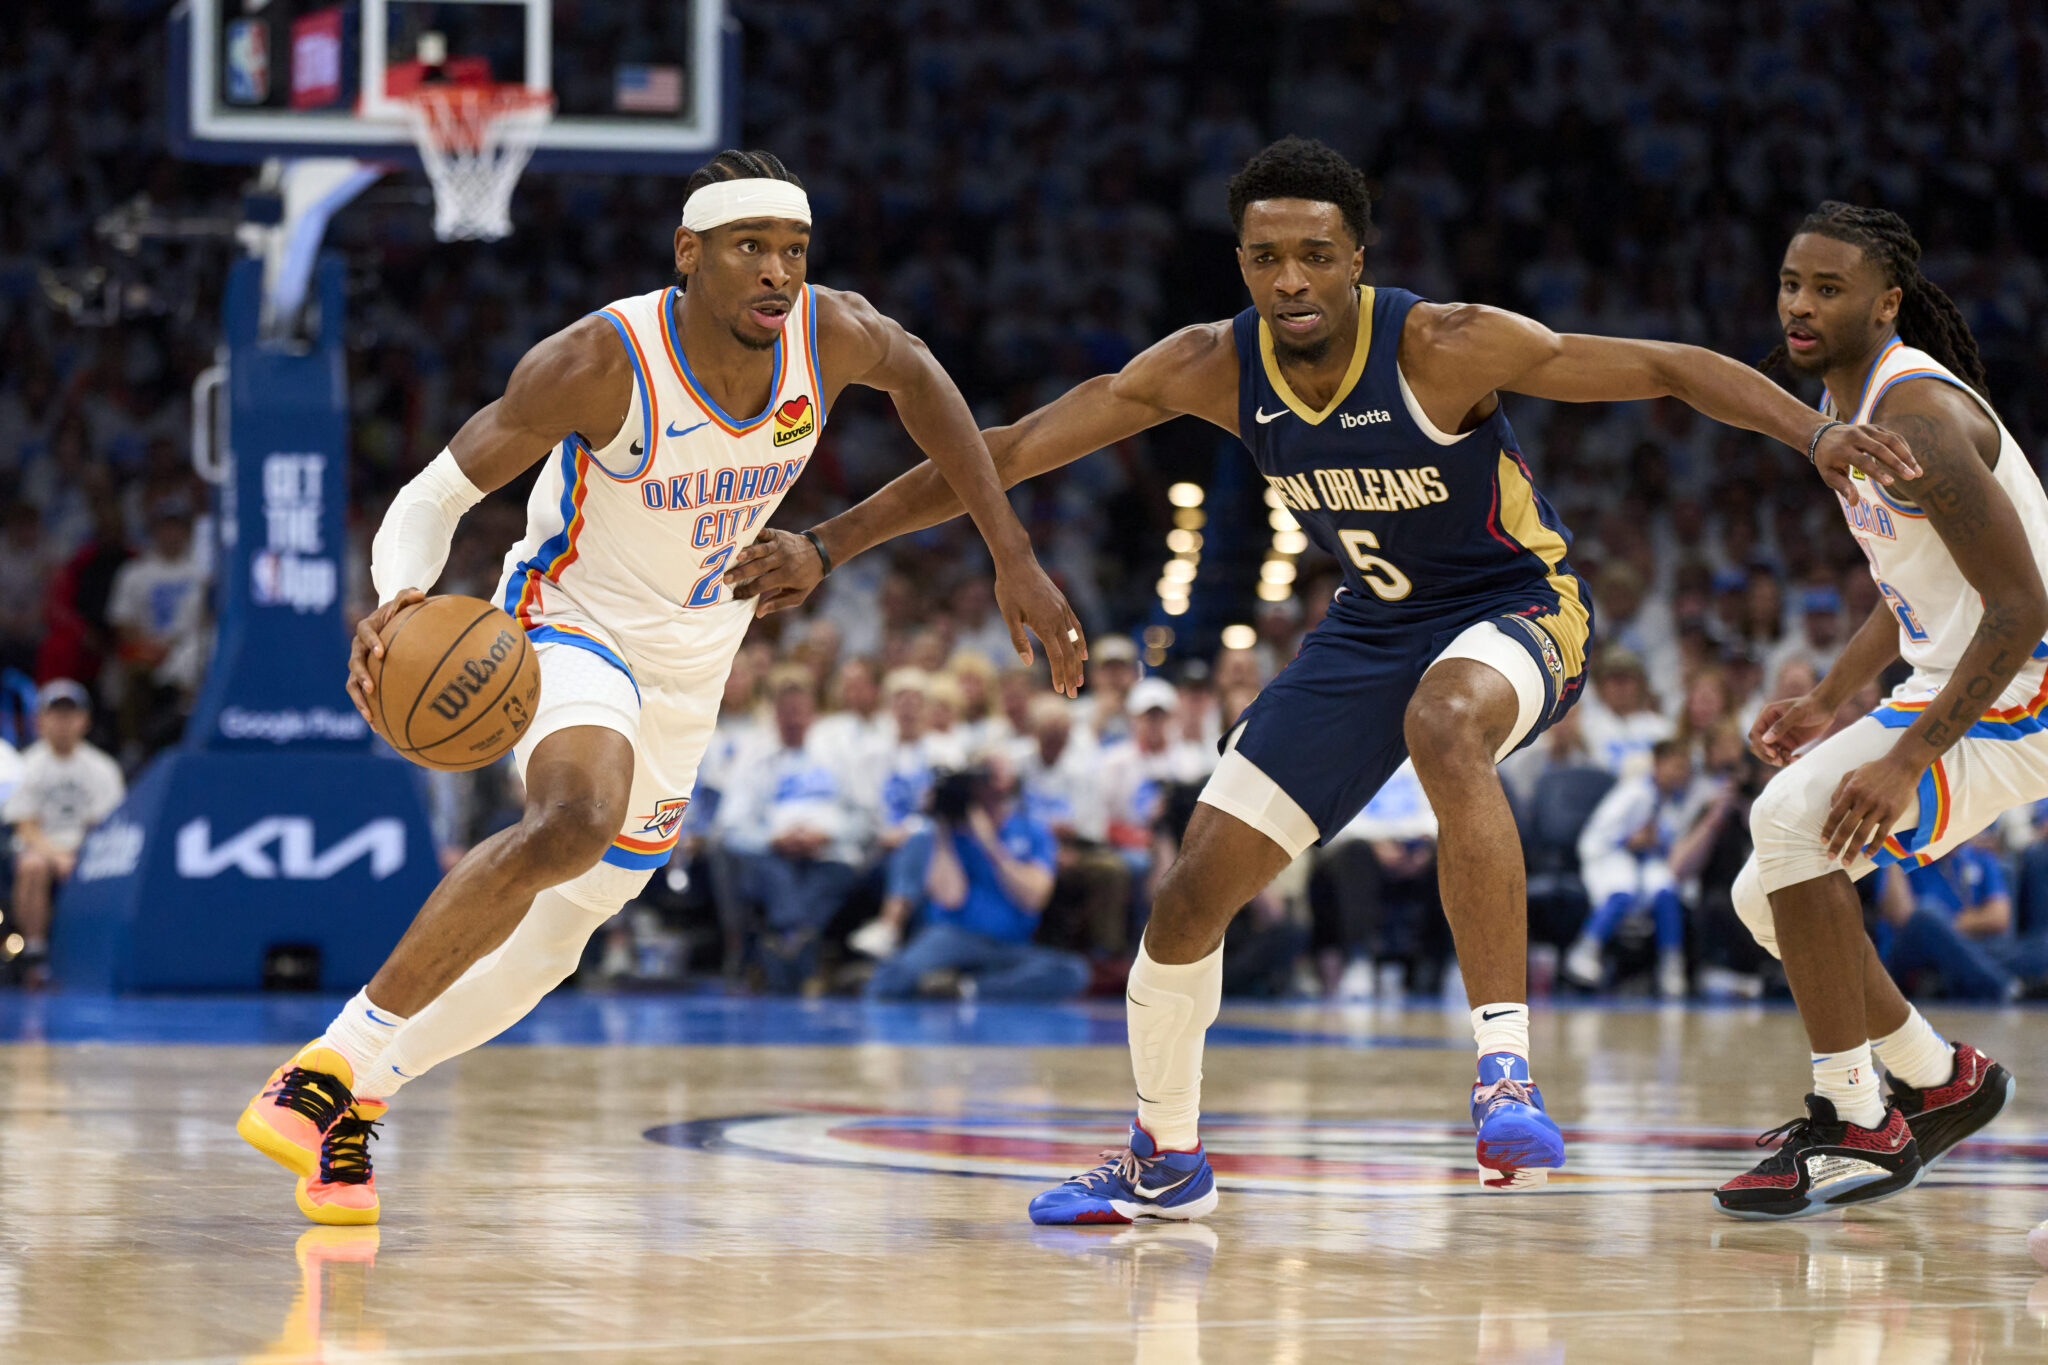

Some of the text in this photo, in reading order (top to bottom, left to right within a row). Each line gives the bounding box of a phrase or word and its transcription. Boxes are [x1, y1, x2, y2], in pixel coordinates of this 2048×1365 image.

[1339, 409, 1391, 429] ibotta
[1313, 466, 1449, 512] ORLEANS
[691, 500, 770, 549] CITY
[682, 541, 736, 609] 2
[1338, 529, 1412, 601] 5
[428, 629, 517, 721] Wilson
[175, 815, 408, 881] KIA
